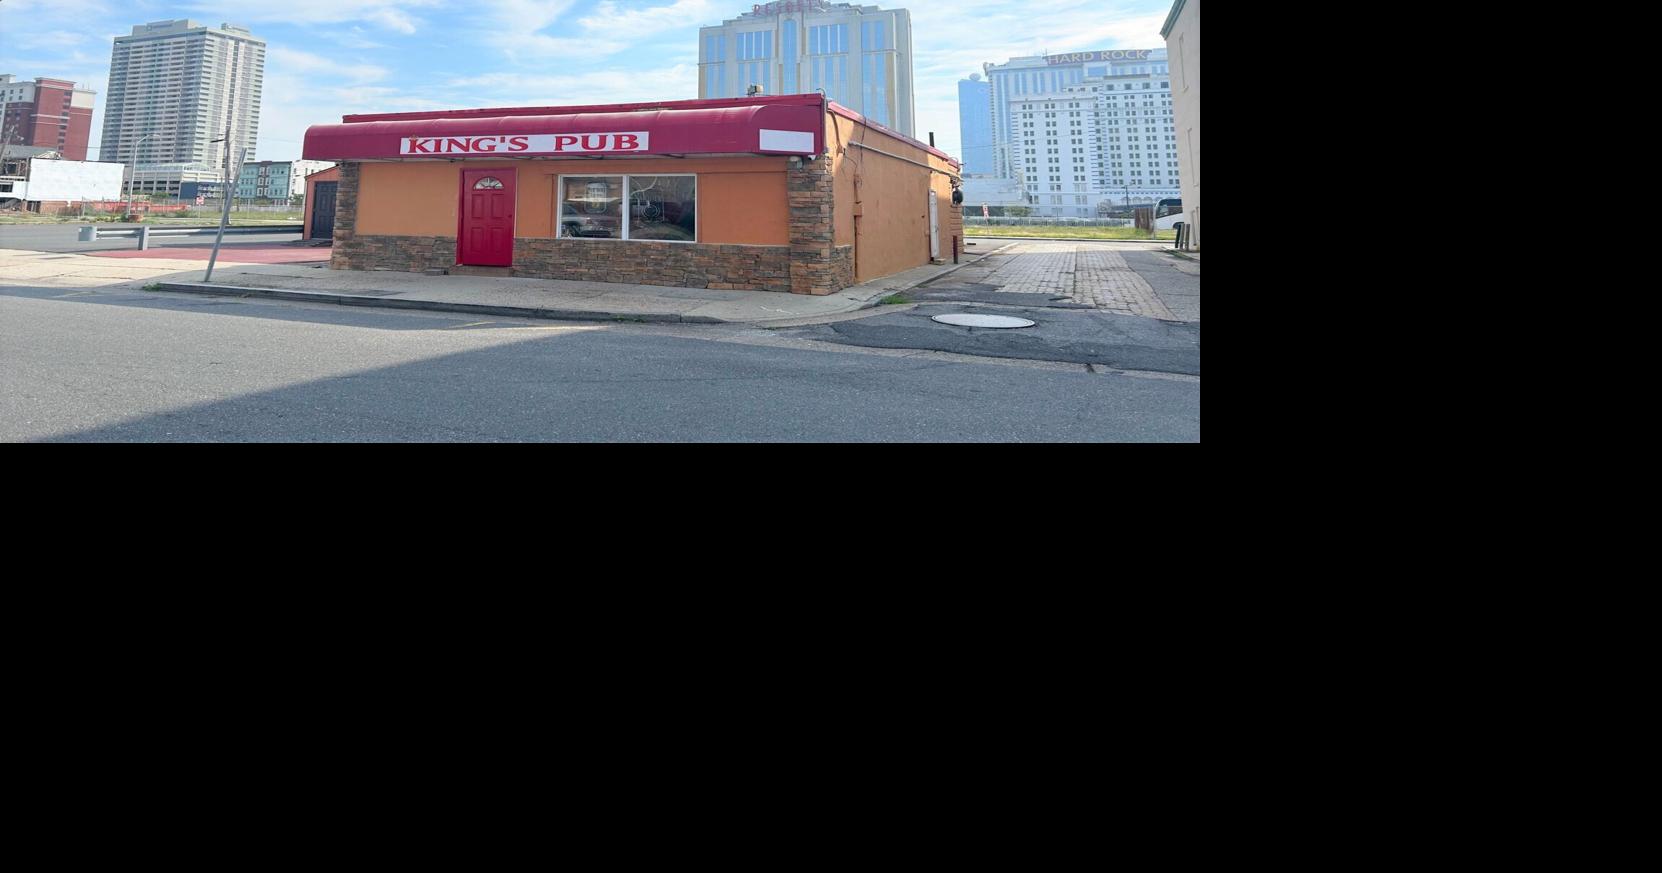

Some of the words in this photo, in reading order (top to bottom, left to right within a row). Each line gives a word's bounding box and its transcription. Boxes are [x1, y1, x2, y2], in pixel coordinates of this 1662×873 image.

[1048, 51, 1094, 65] HARD
[1100, 50, 1147, 61] ROCK
[407, 136, 529, 153] KING'S
[554, 134, 640, 151] PUB
